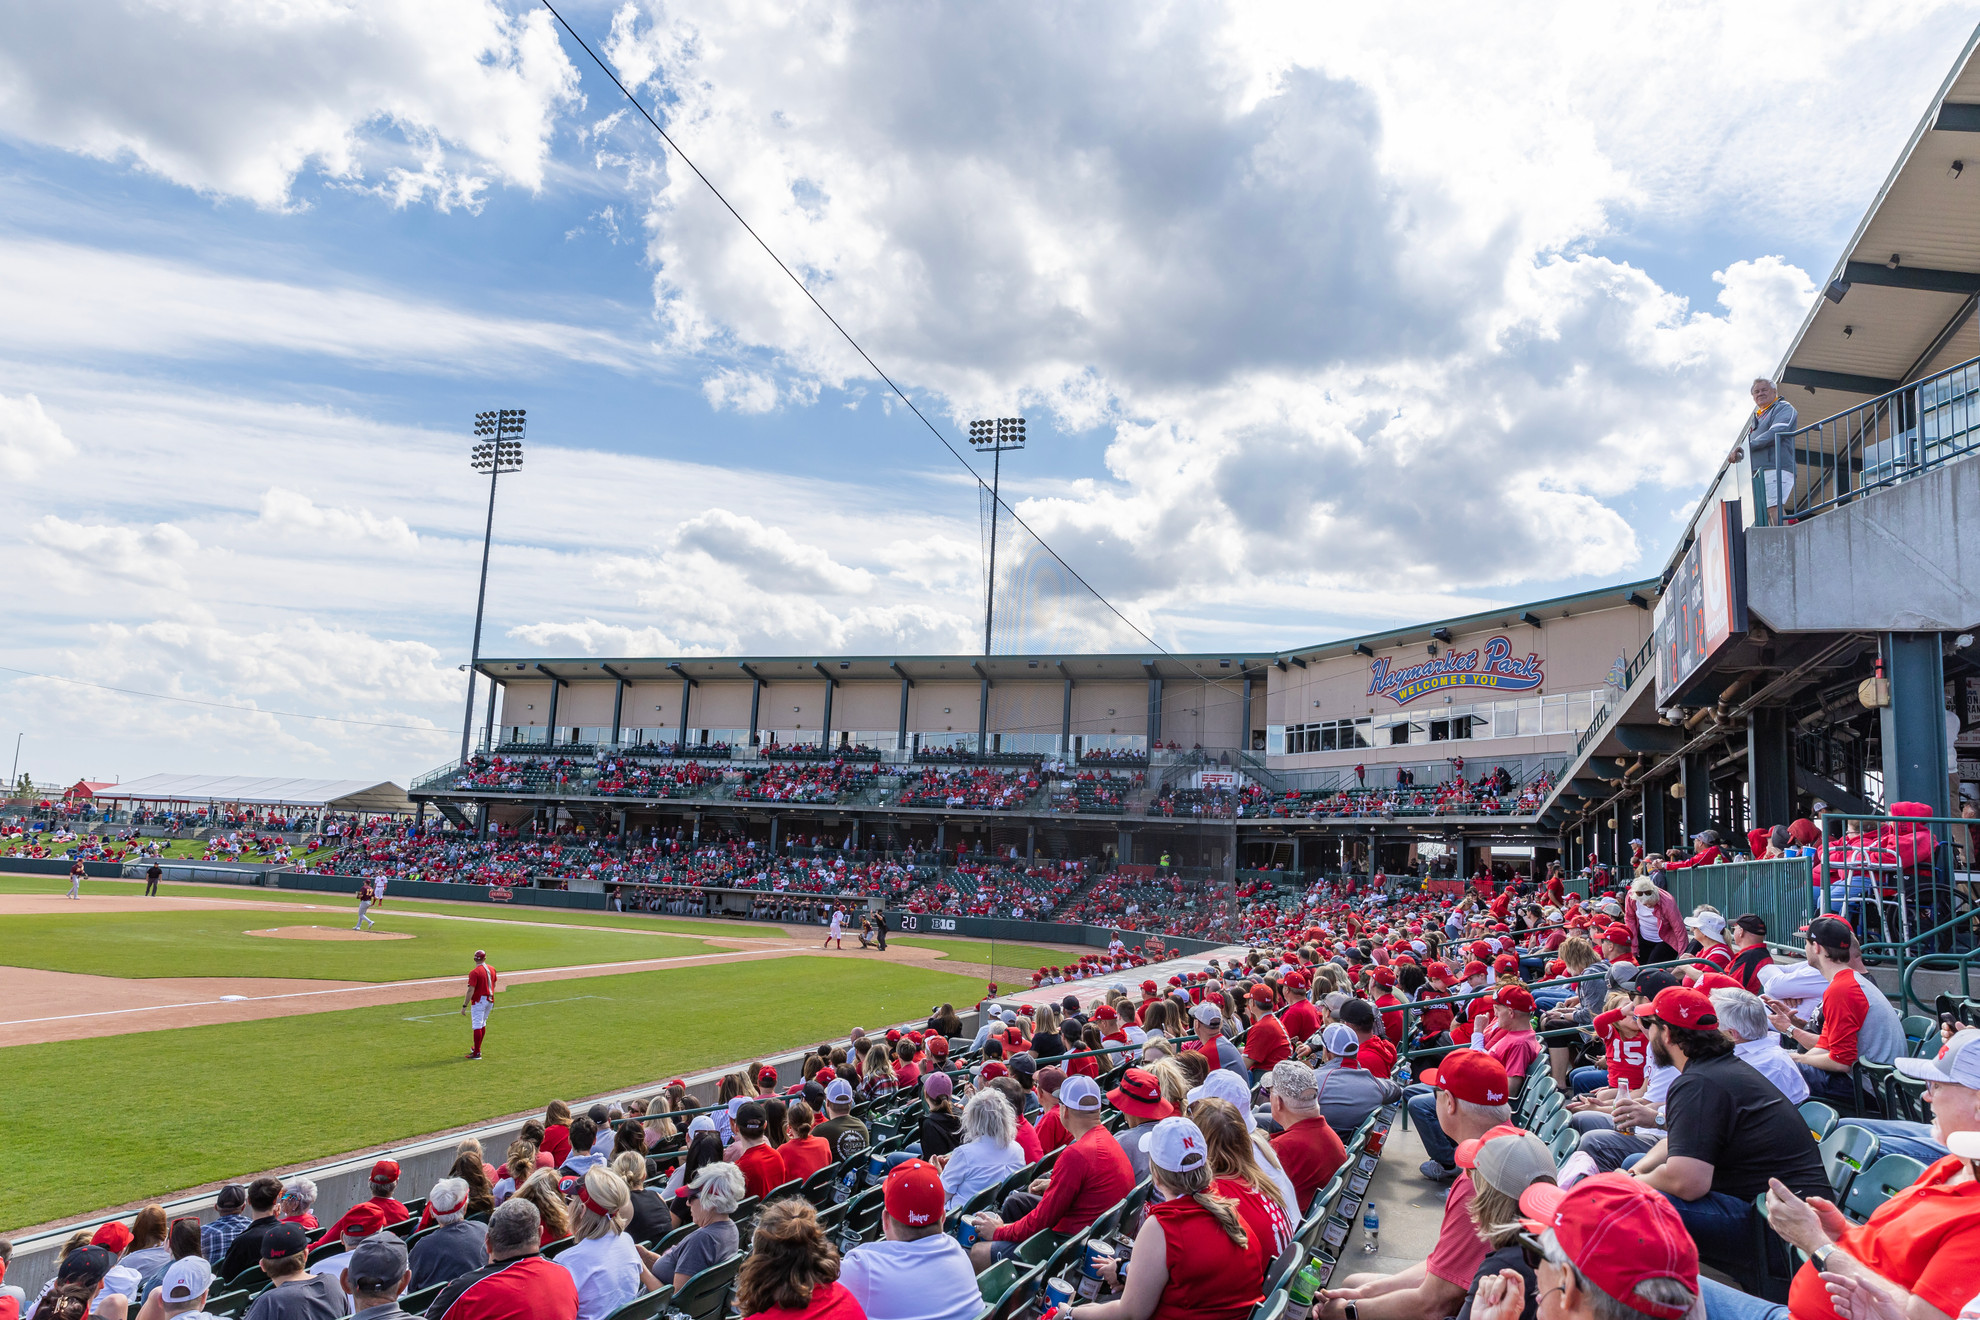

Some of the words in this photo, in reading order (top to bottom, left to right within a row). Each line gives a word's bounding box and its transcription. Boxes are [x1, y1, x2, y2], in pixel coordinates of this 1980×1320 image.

[1367, 649, 1478, 695] Haymarket
[1482, 636, 1542, 680] Park
[1398, 675, 1467, 700] WELCOMES
[1473, 675, 1498, 686] YOU
[1201, 773, 1233, 783] ESPN
[901, 915, 917, 930] 20
[1612, 1038, 1645, 1066] 15
[1182, 1136, 1195, 1149] N
[908, 1209, 930, 1224] Huskers
